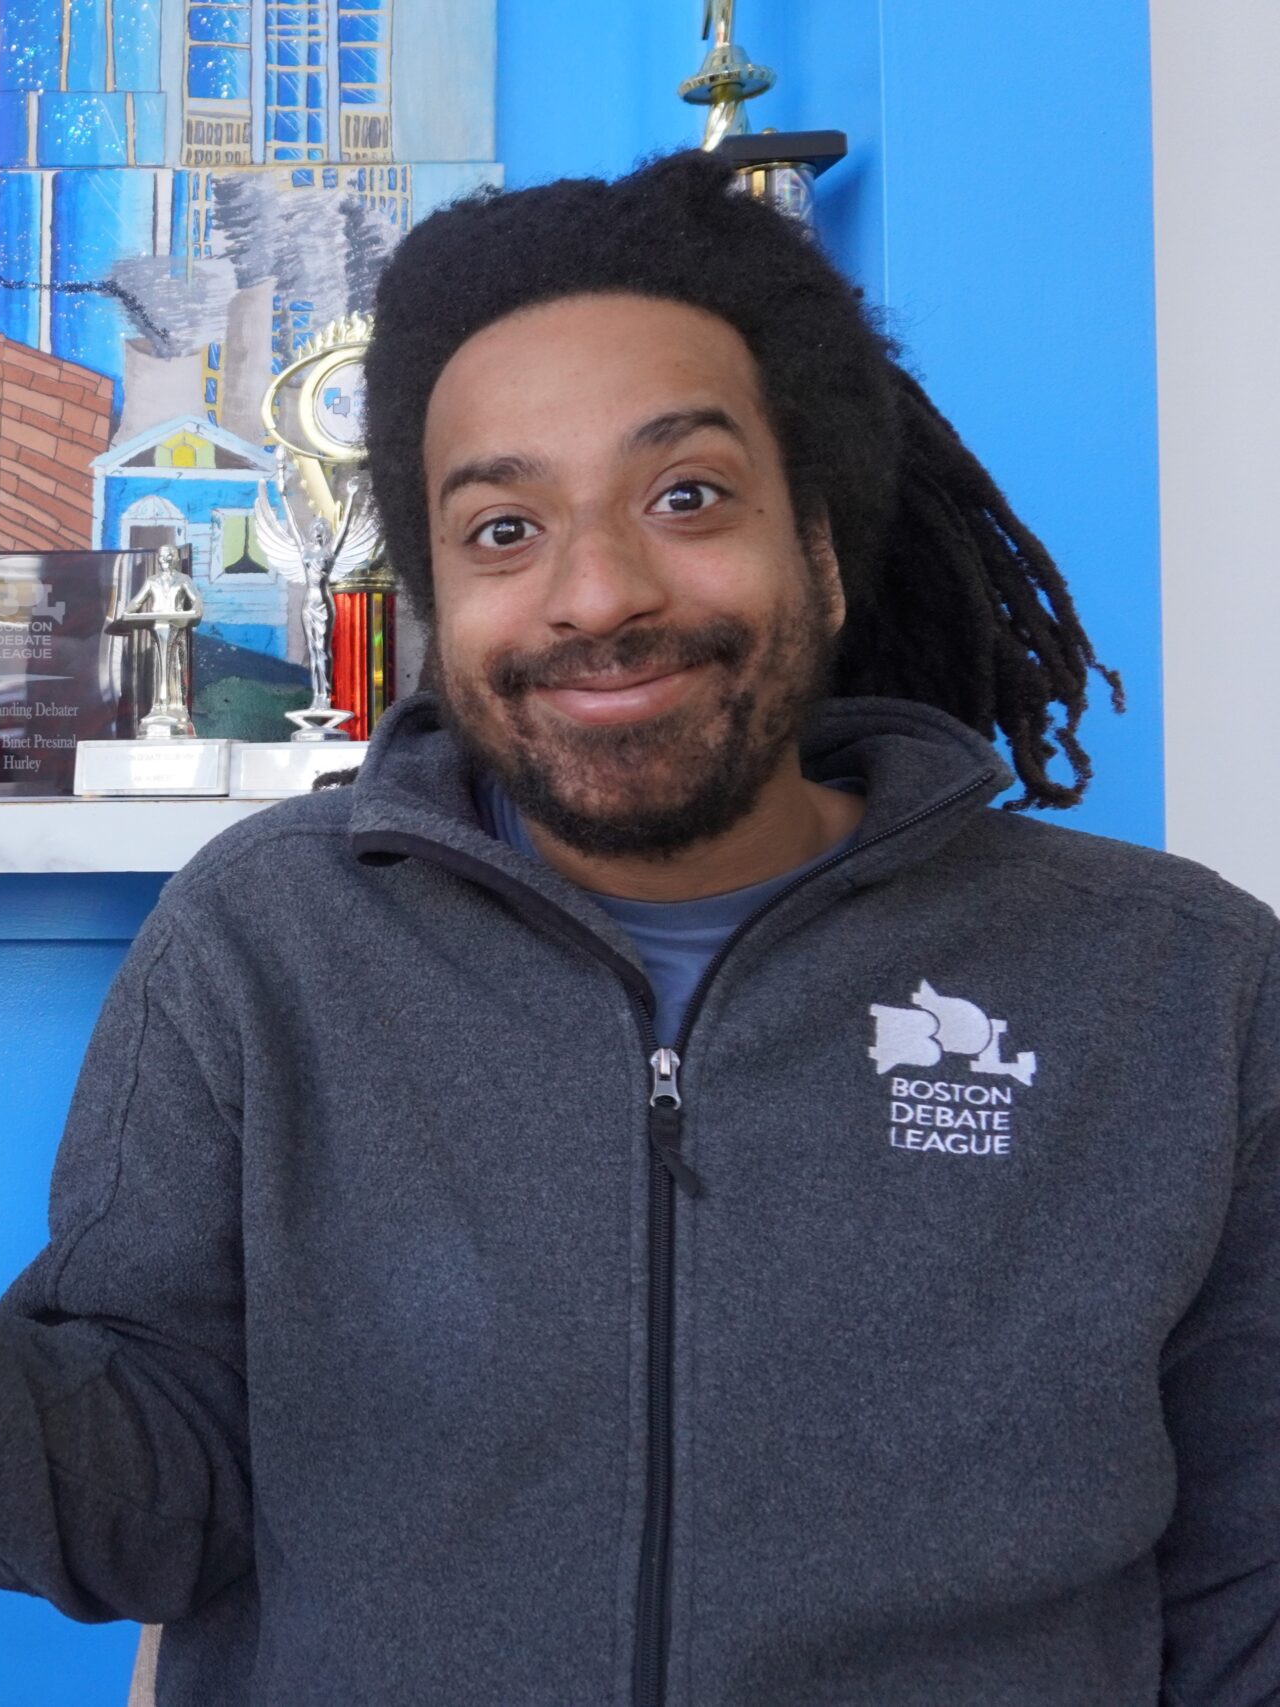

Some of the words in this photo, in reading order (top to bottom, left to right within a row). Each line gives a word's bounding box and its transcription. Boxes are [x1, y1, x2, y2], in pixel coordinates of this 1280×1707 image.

[35, 702, 79, 717] Debater
[1, 734, 30, 749] Binet
[34, 734, 78, 749] Presinal
[3, 755, 42, 772] Hurley
[891, 1077, 1012, 1106] BOSTON
[890, 1101, 1011, 1131] DEBATE
[889, 1126, 1011, 1155] LEAGUE
